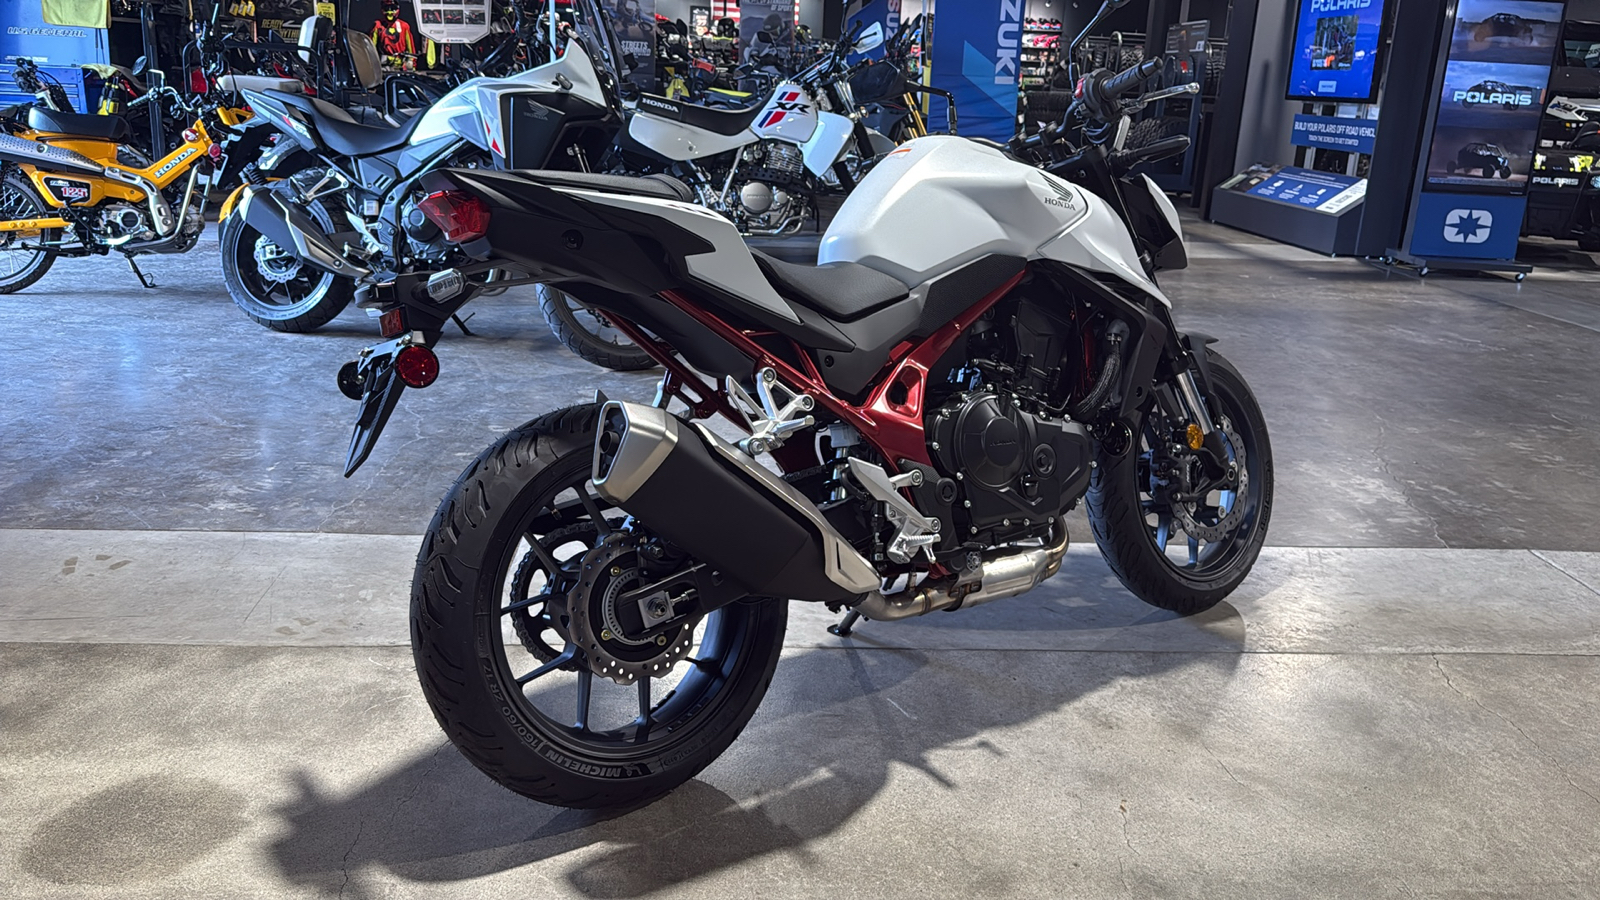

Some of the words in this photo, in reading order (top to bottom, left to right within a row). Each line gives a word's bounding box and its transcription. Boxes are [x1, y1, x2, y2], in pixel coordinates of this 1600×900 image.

[1310, 0, 1371, 13] POLARIS
[261, 19, 283, 29] READY
[621, 40, 649, 50] STREETS
[642, 97, 679, 113] HONDA
[1453, 91, 1532, 105] POLARIS
[767, 102, 811, 114] XR
[1294, 121, 1307, 131] BUILD
[1307, 122, 1318, 132] YOUR
[1318, 123, 1336, 134] POLARIS
[1336, 124, 1345, 134] OFF
[1345, 125, 1358, 136] ROAD
[1359, 126, 1376, 138] VEHICL
[154, 148, 198, 178] HONDA
[1532, 177, 1579, 186] POLARIS
[61, 186, 88, 198] 125
[1044, 197, 1077, 211] HONDA
[483, 663, 494, 683] 17
[489, 682, 503, 702] ZR
[502, 706, 539, 750] 160/60
[545, 749, 622, 779] MICHELIN
